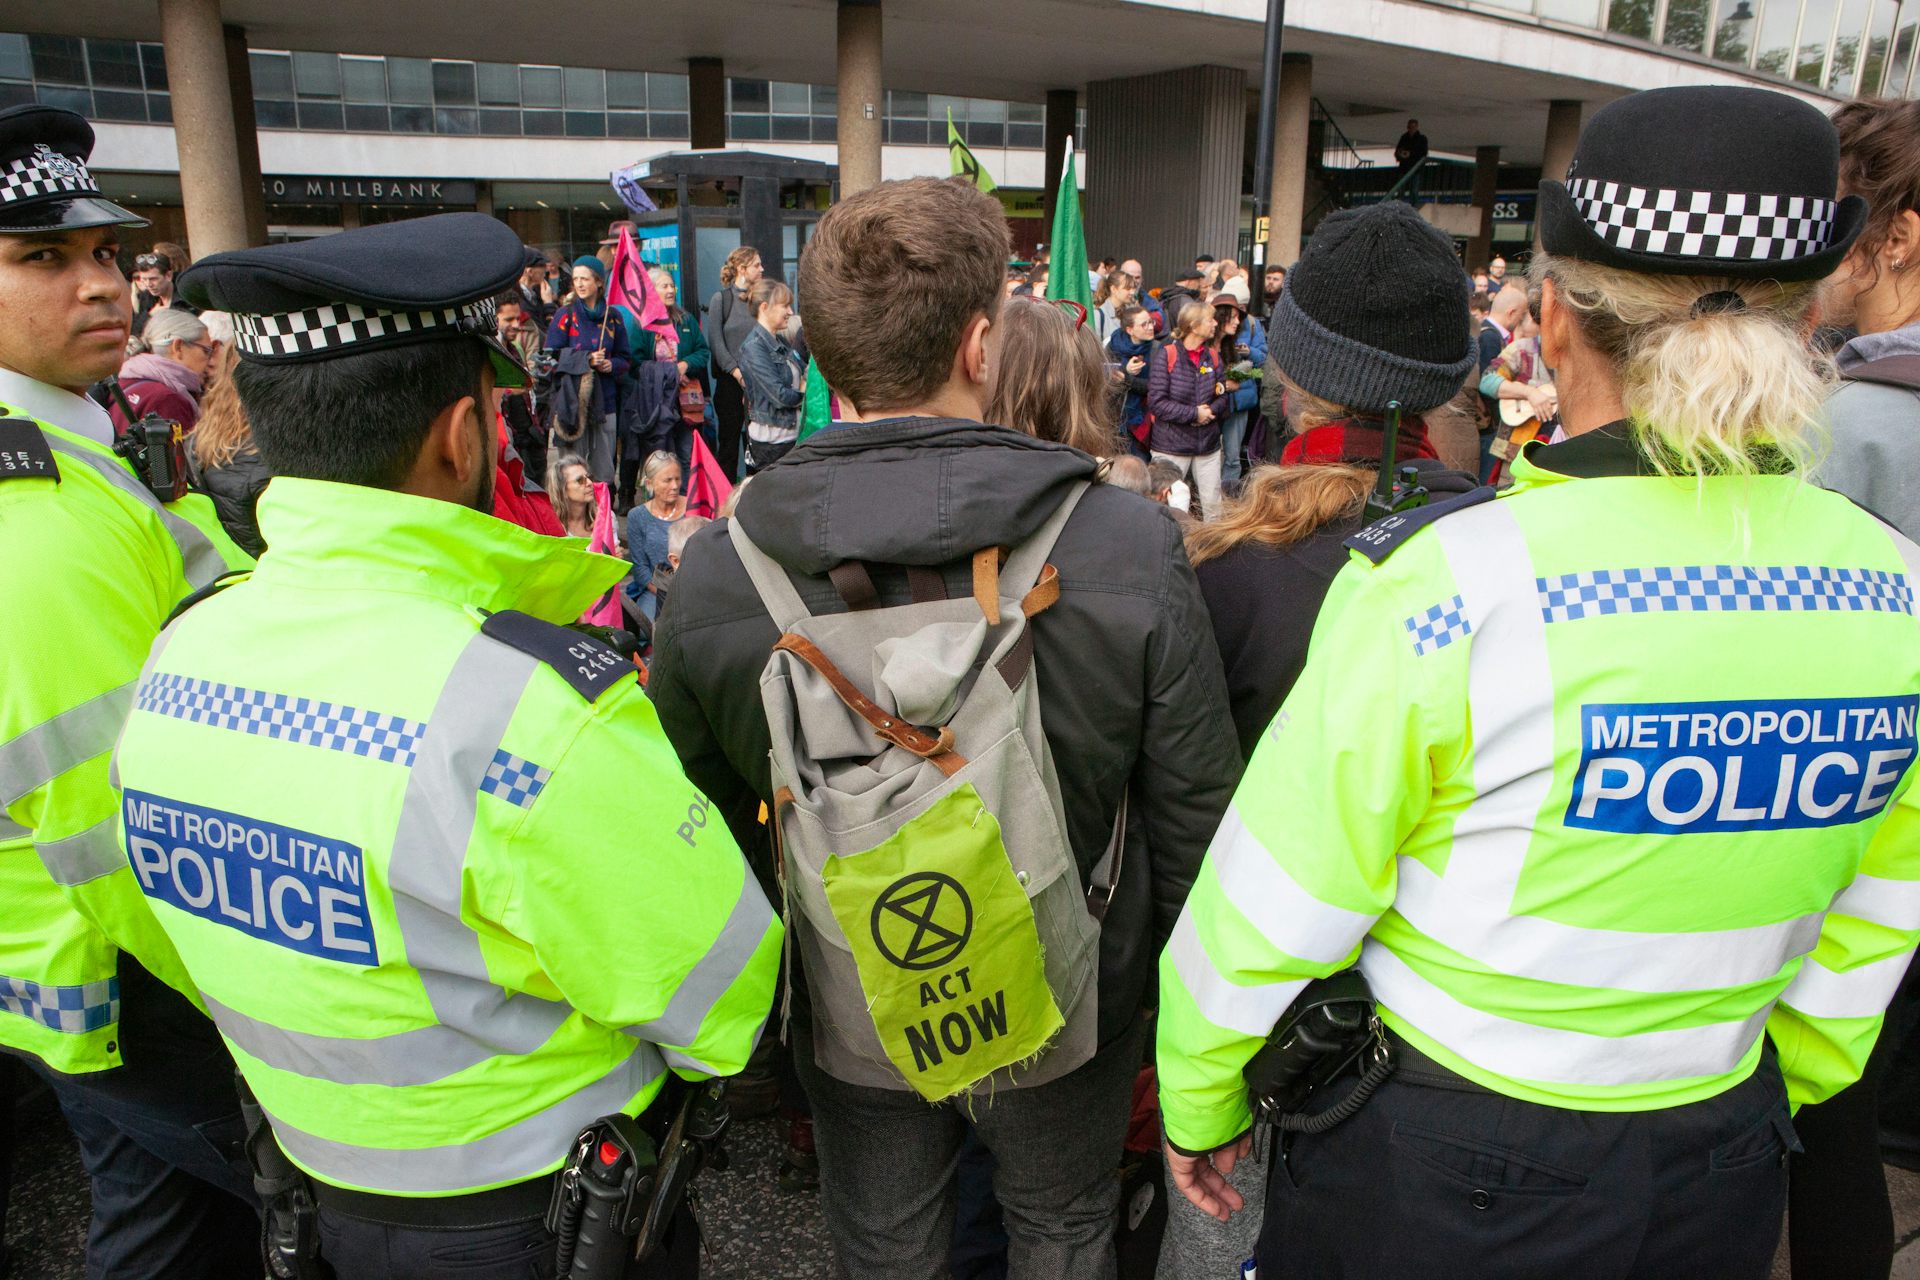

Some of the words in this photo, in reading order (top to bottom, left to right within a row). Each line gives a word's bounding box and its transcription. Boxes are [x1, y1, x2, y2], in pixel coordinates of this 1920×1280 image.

[306, 182, 442, 197] MILLBANK
[1, 451, 30, 461] SE
[568, 641, 598, 660] CN
[1591, 705, 1916, 750] METROPOLITAN
[1576, 747, 1913, 826] POLICE
[127, 797, 360, 886] METROPOLITAN
[130, 835, 371, 954] POLICE
[920, 966, 972, 1008] ACT
[904, 990, 1008, 1072] NOW
